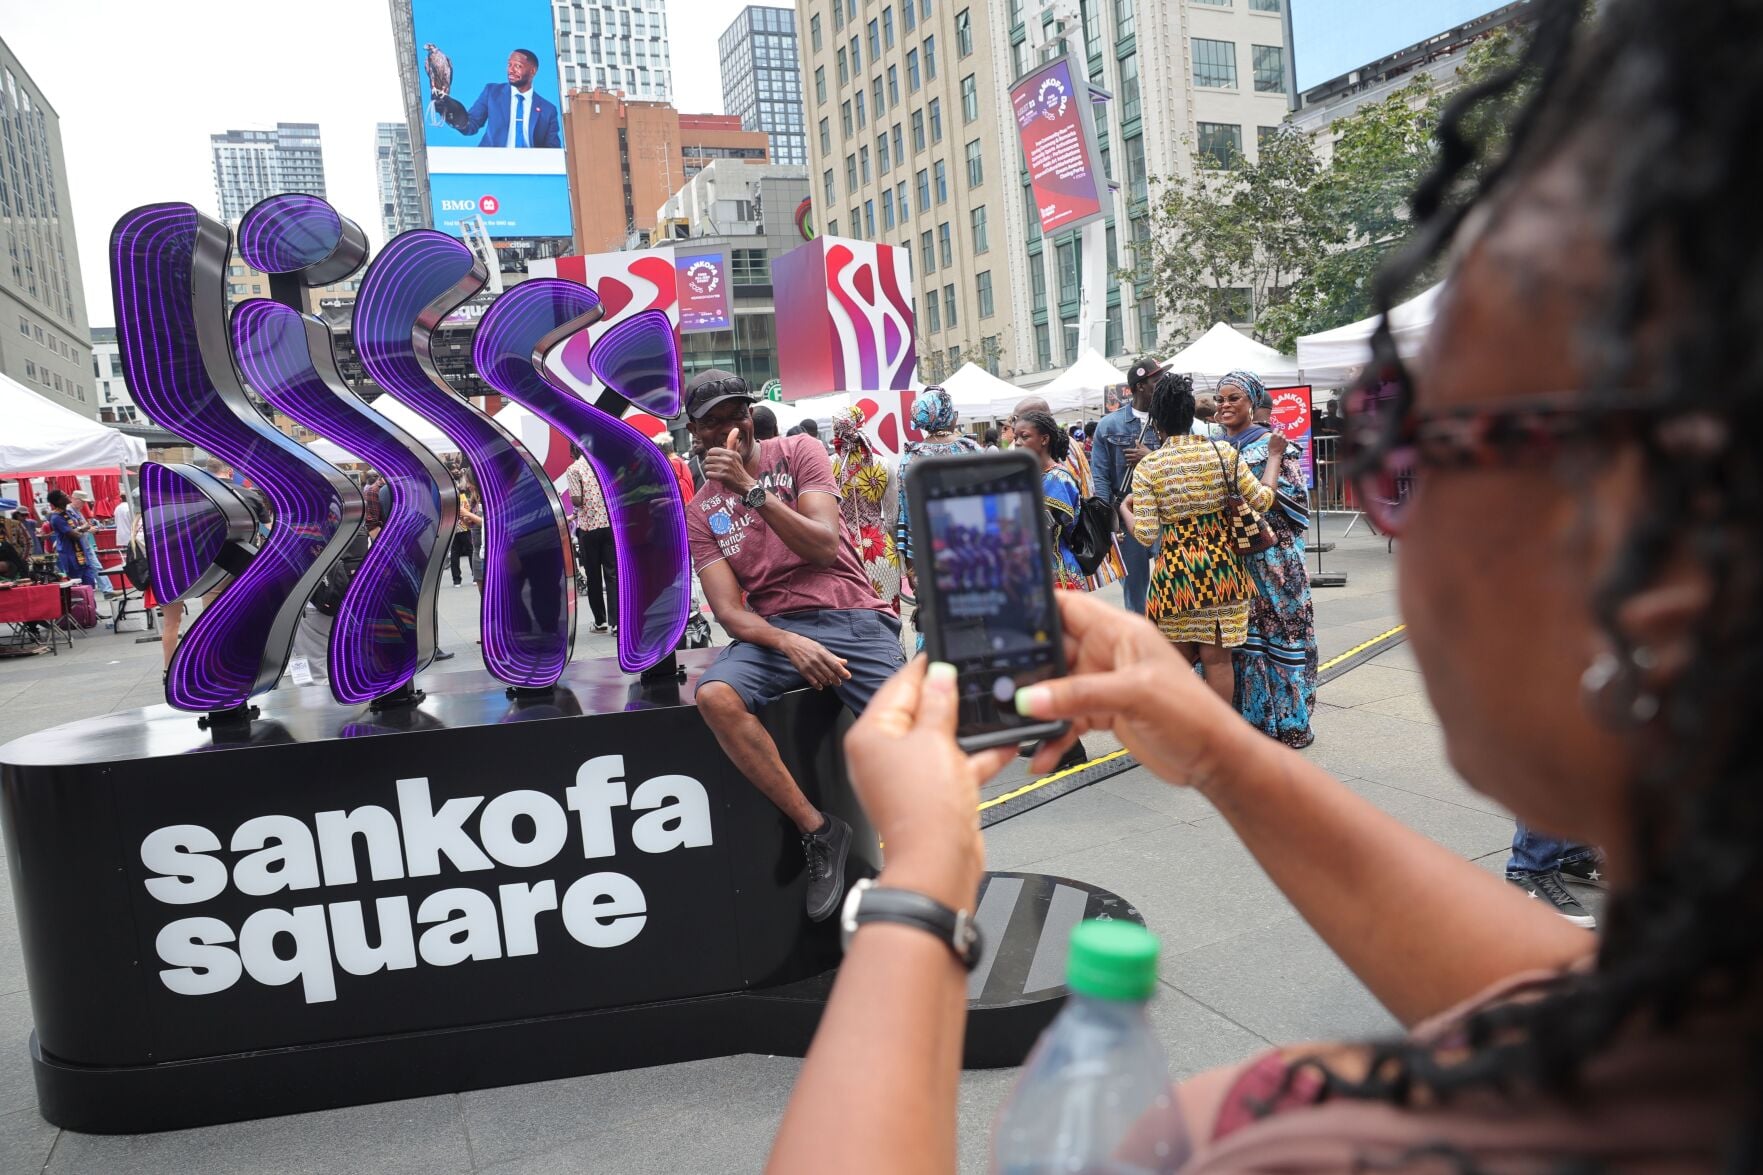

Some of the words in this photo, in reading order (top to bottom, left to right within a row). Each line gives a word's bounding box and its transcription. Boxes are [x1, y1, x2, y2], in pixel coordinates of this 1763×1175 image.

[1038, 78, 1064, 102] SANKOFA
[1058, 96, 1068, 116] DAY
[442, 200, 476, 210] BMO
[687, 261, 718, 276] SANKOFA
[708, 277, 719, 292] DAY
[1272, 392, 1307, 414] SANKOFA
[1288, 416, 1304, 430] DAY
[140, 754, 713, 904] sankofa
[155, 871, 647, 1004] square
